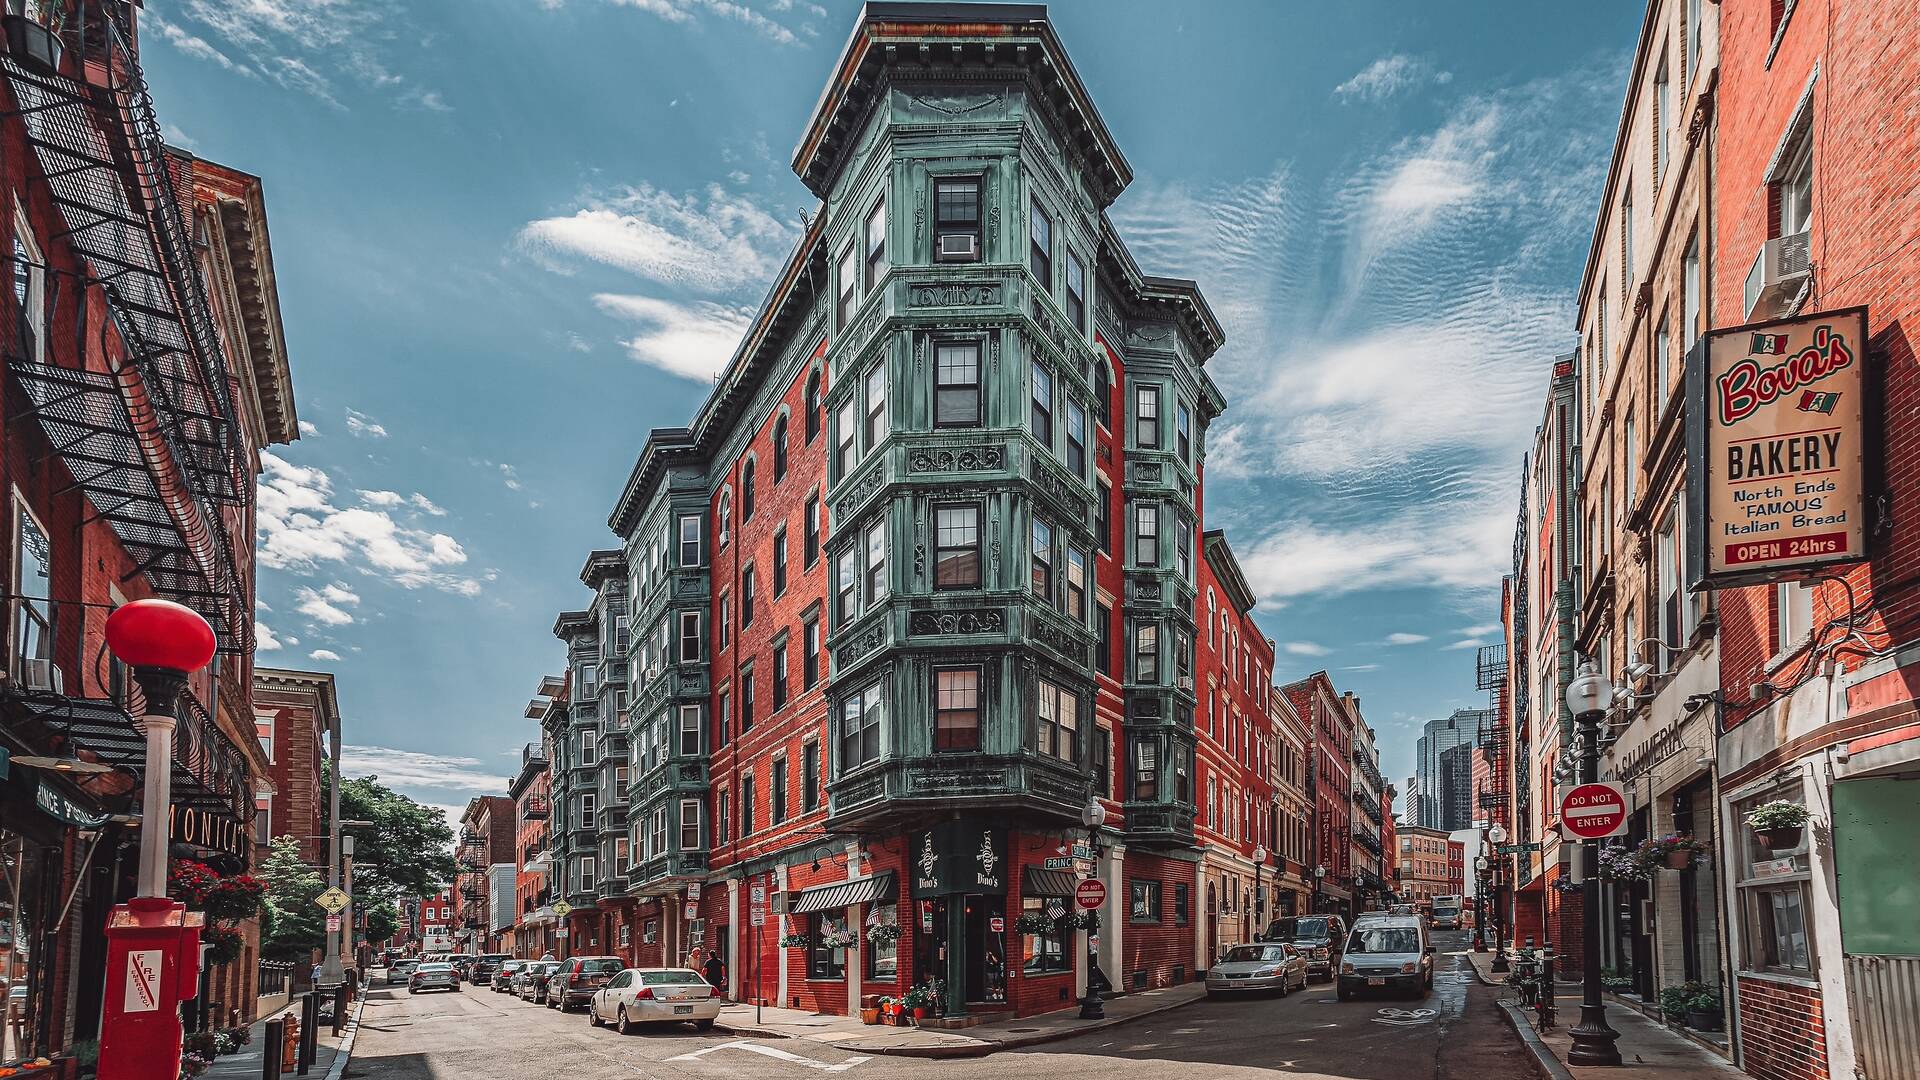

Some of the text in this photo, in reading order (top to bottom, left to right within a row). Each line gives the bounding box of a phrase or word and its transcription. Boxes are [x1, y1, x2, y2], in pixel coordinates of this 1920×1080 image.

[1717, 325, 1853, 425] Bova's
[1728, 432, 1841, 480] BAKERY
[1733, 478, 1836, 502] North End's
[1725, 510, 1847, 536] Italian Bread
[1737, 539, 1837, 561] OPEN 24hrs
[1622, 719, 1682, 778] SALUMERIA
[1571, 794, 1612, 806] DO NOT
[1577, 816, 1612, 828] ENTER
[1047, 858, 1072, 868] PRINC
[919, 876, 938, 889] Dino's
[977, 872, 999, 888] Dino's
[137, 953, 156, 982] FIRE
[131, 969, 151, 1008] EMERGENCY
